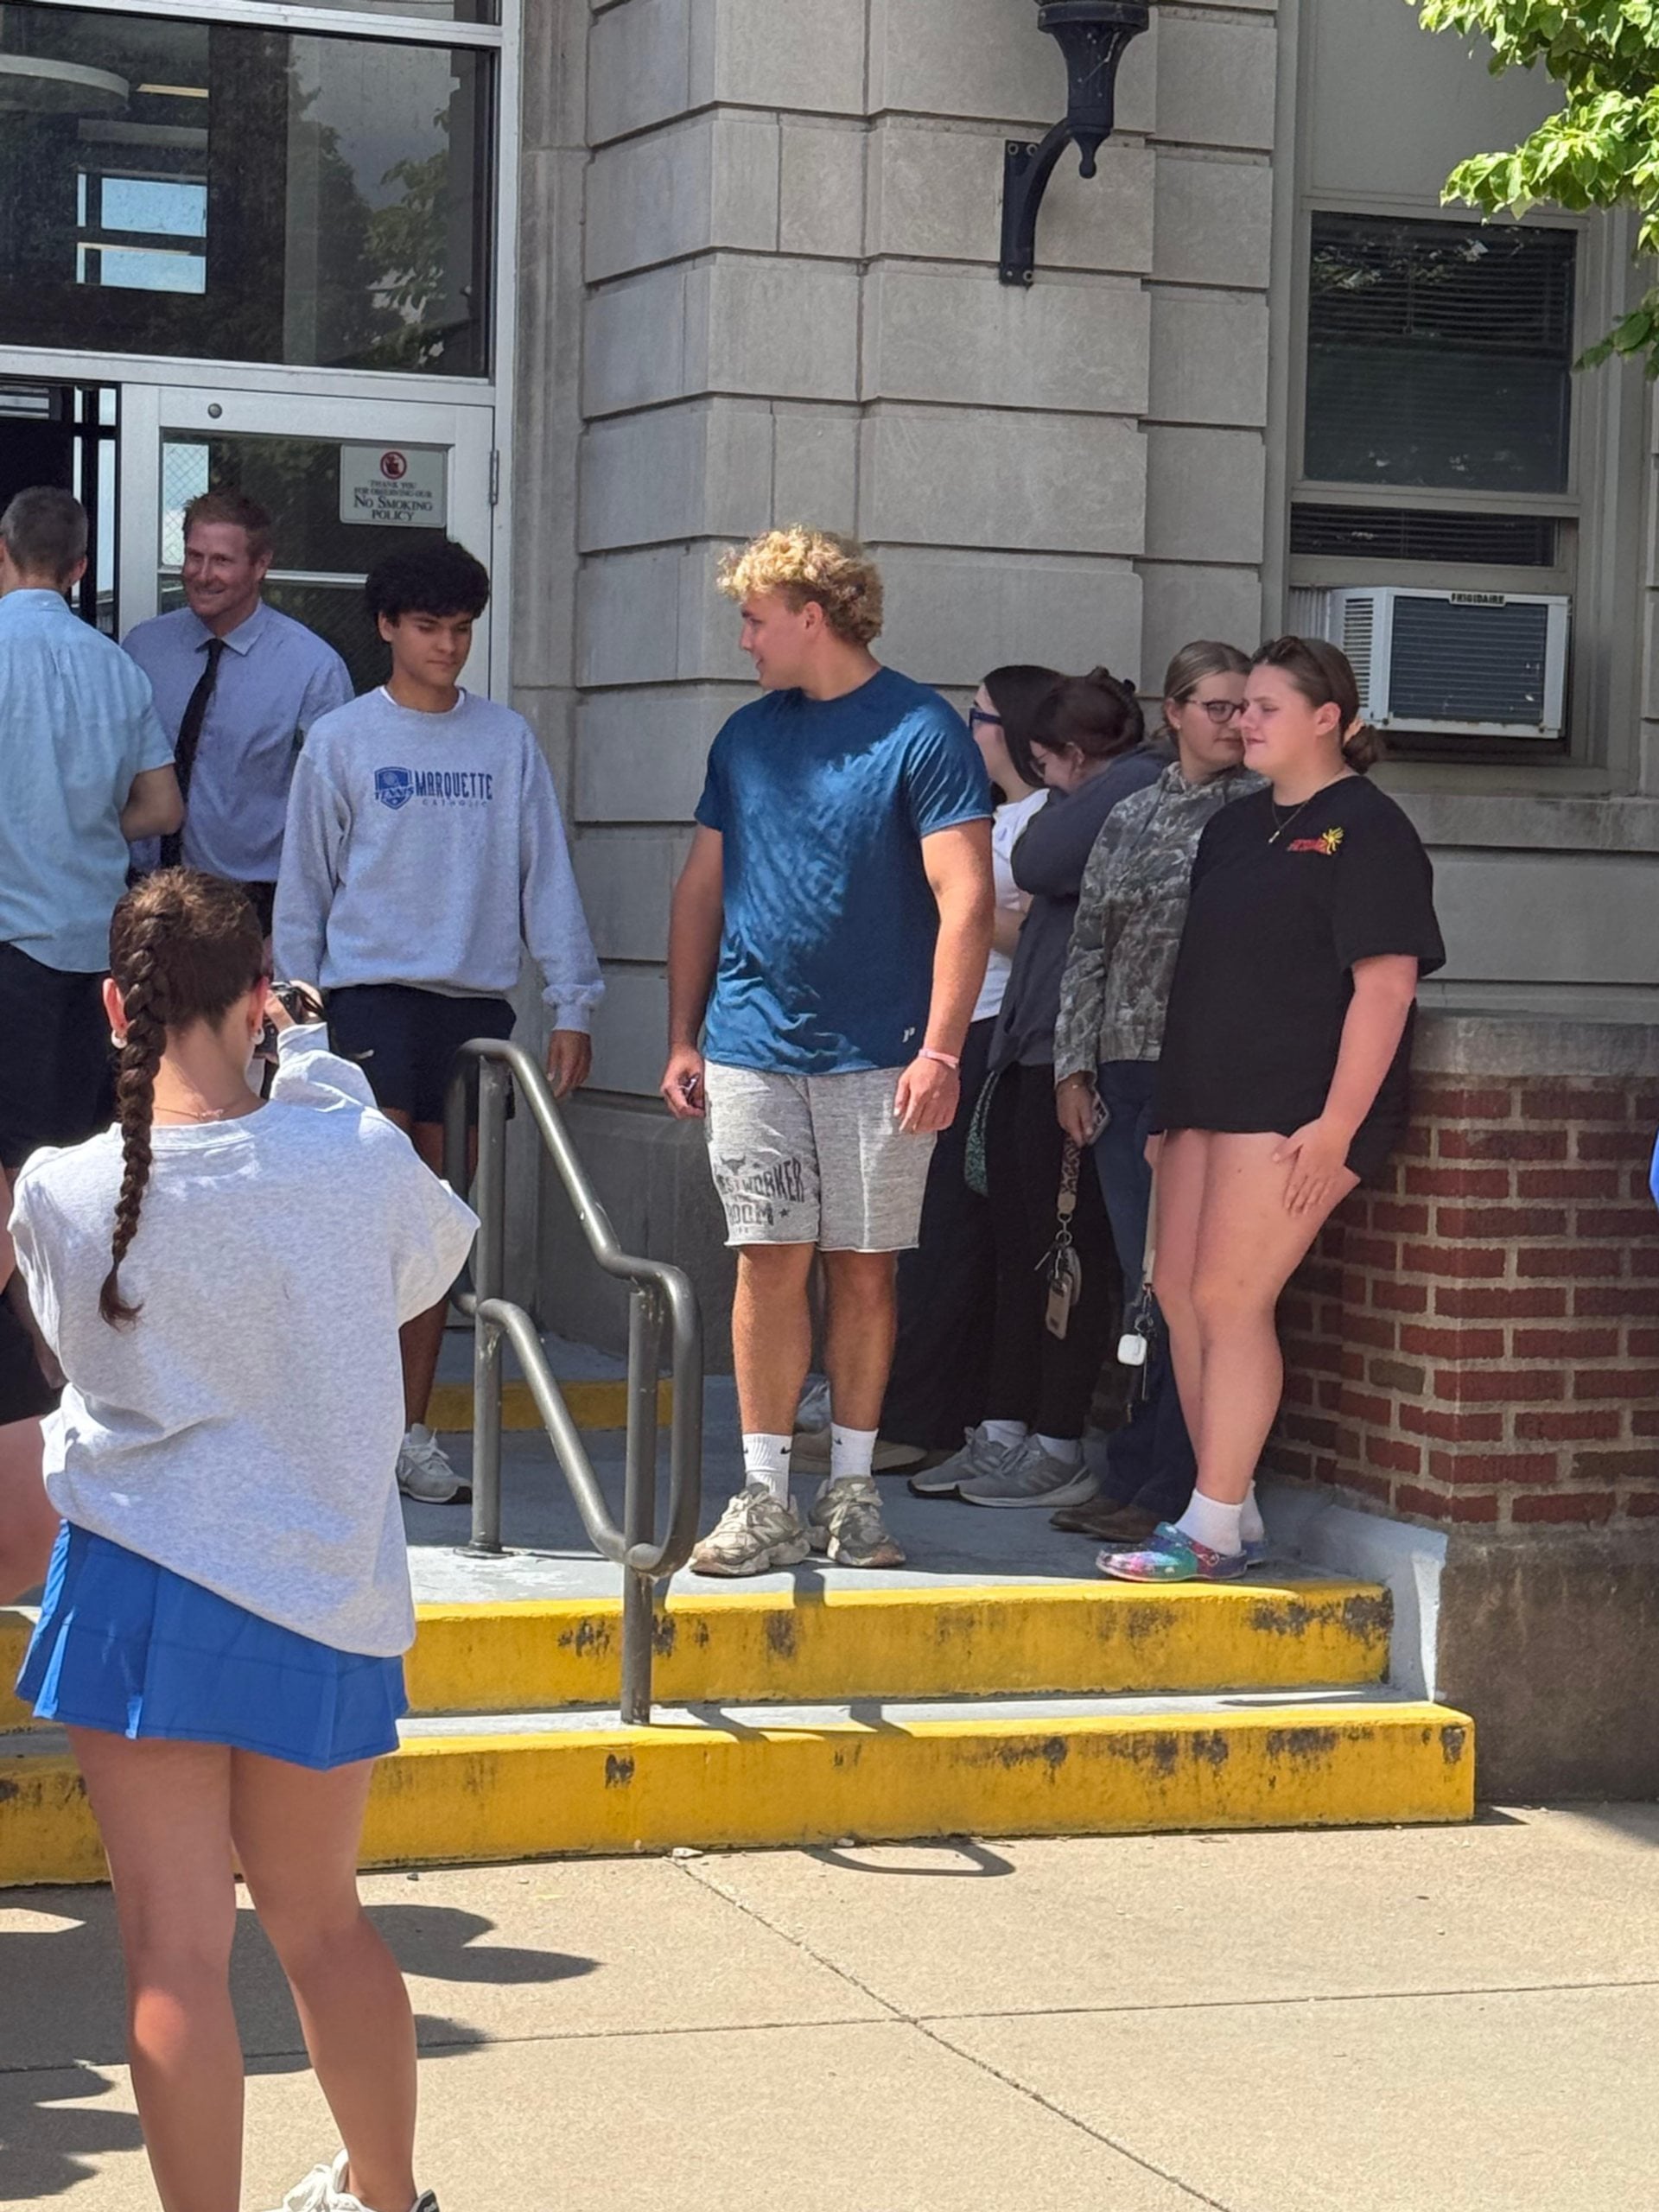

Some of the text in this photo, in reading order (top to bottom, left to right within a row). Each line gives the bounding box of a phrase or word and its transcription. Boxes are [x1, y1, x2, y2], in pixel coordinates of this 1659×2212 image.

[372, 509, 414, 521] POLICY
[1451, 593, 1505, 604] FRIGIDAIRE
[415, 770, 493, 800] MARQUETTE
[422, 798, 488, 809] CATHOLIC
[742, 1156, 805, 1204] WORKER
